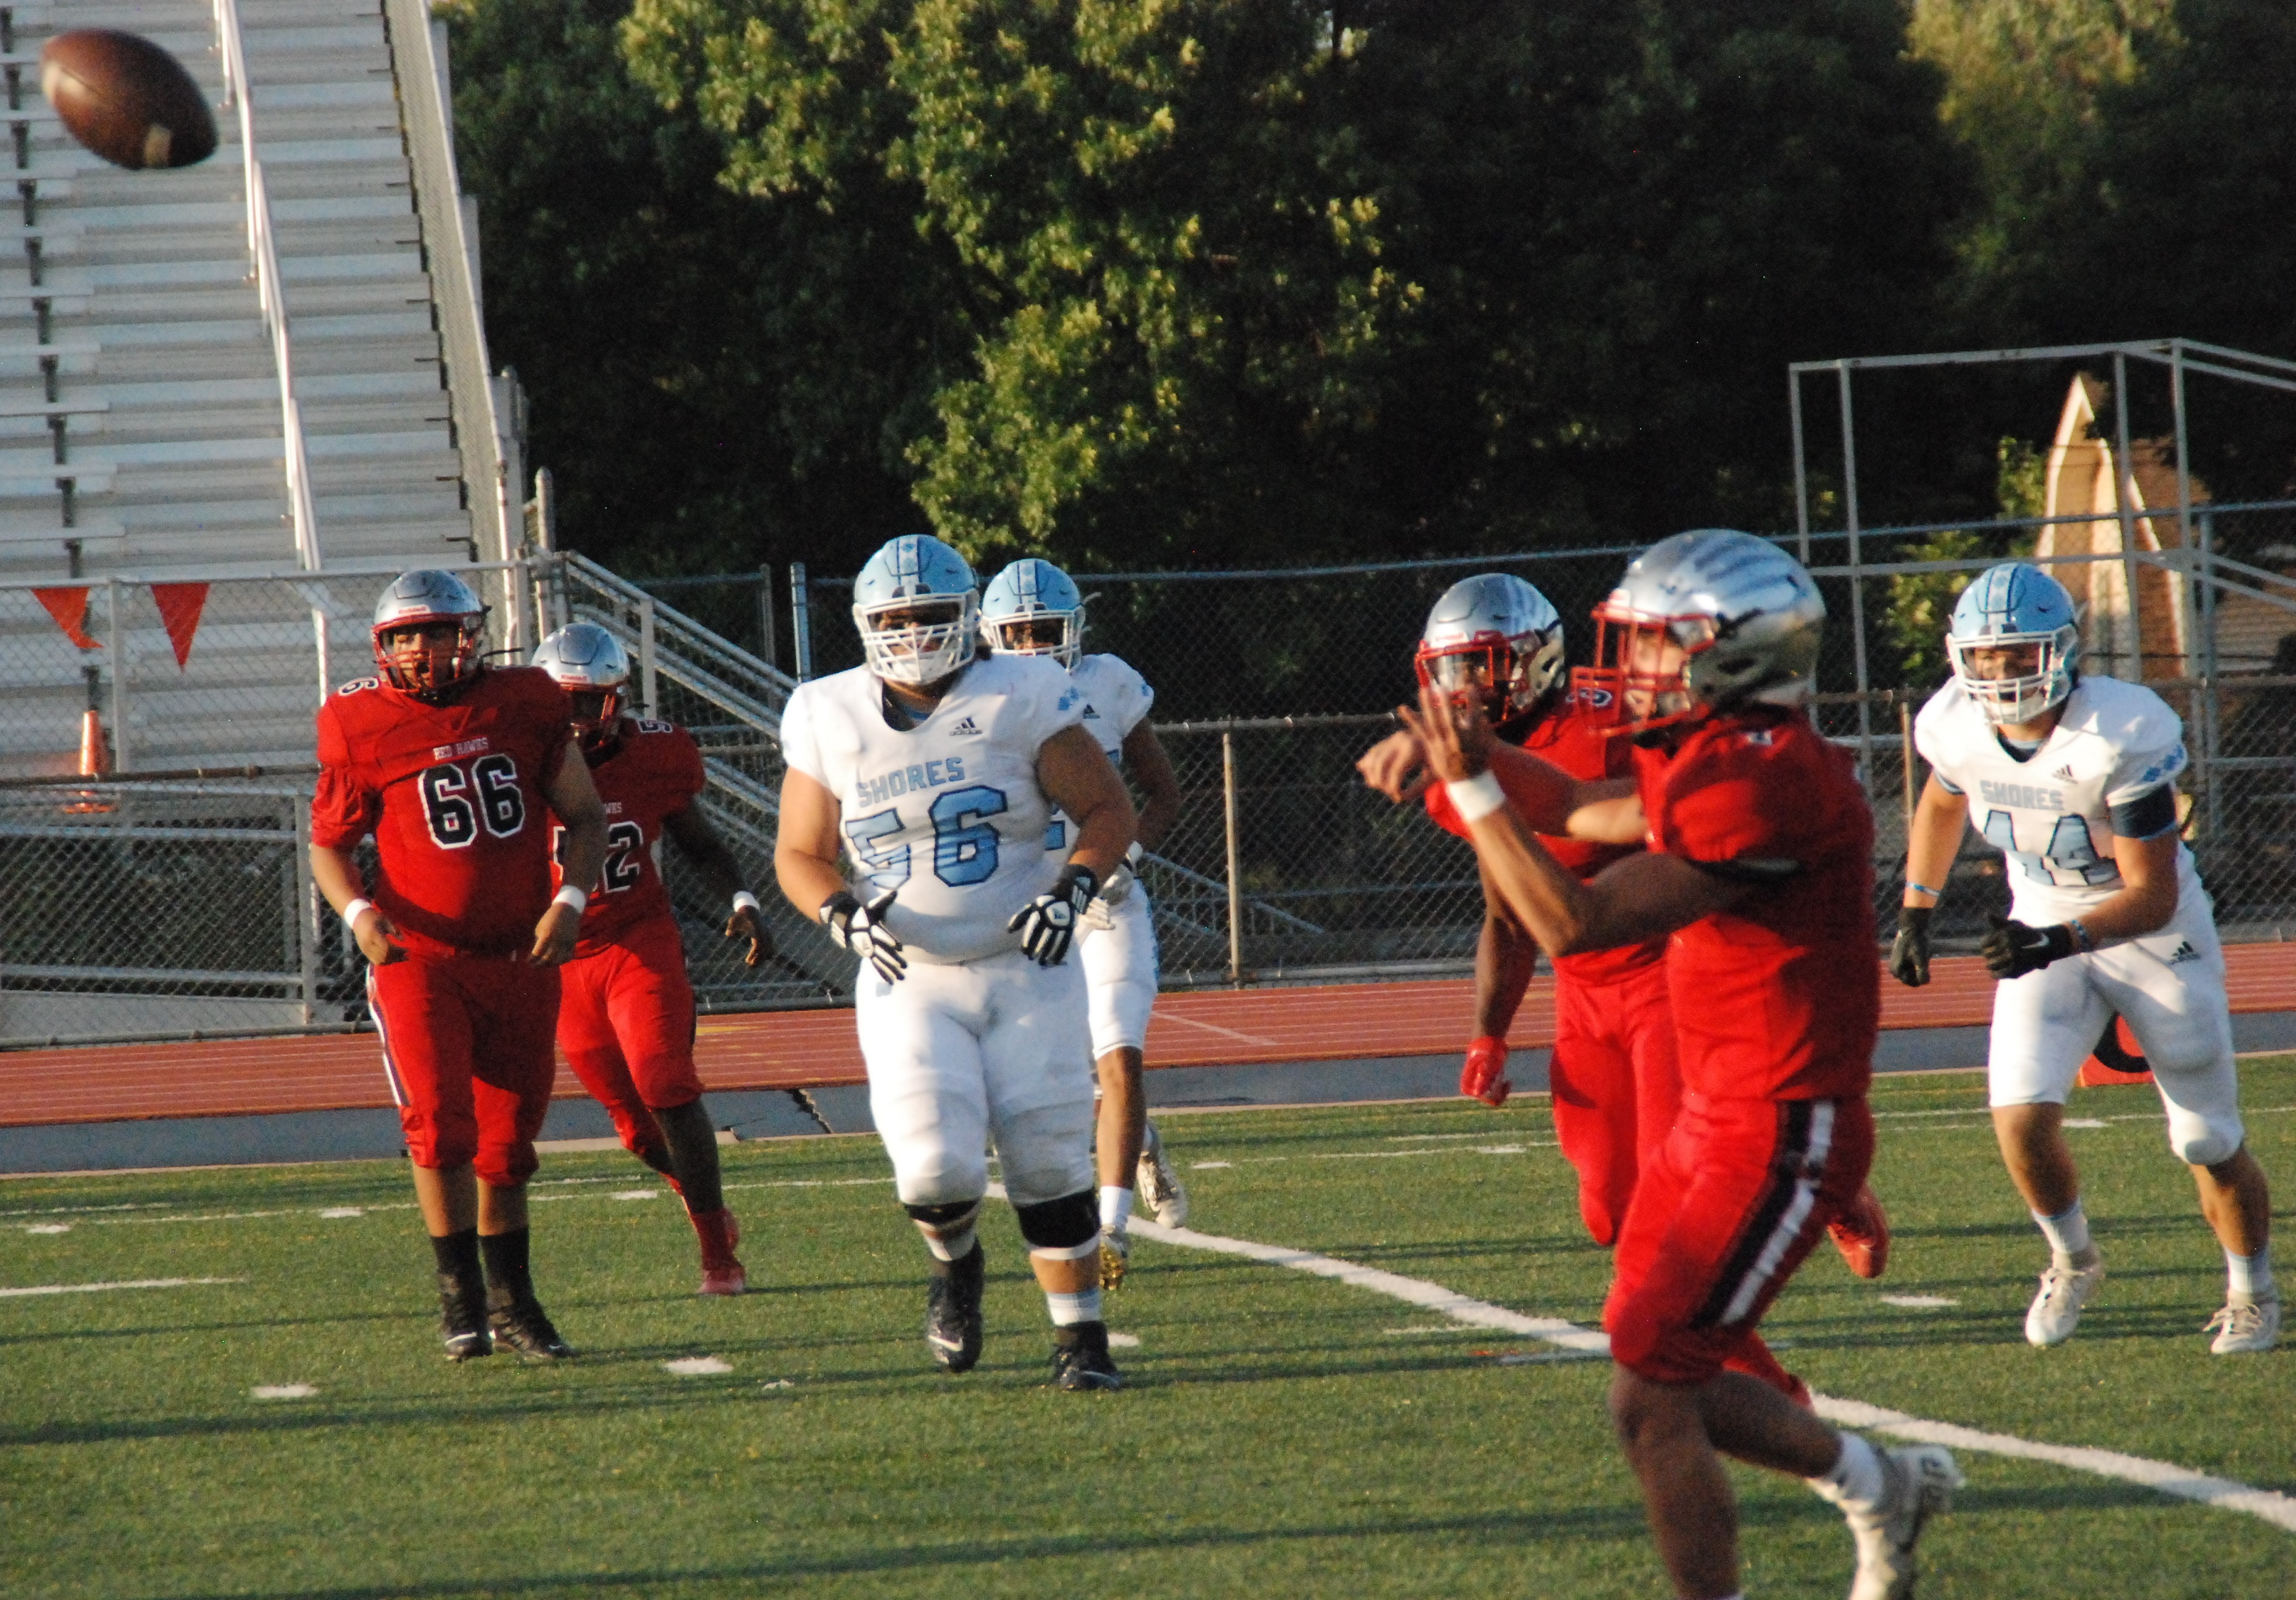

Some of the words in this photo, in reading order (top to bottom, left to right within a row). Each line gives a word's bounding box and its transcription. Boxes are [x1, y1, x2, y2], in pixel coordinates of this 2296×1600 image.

[433, 745, 453, 761] RED
[856, 756, 966, 808] SHORES
[417, 753, 525, 850] 66
[1979, 779, 2065, 811] SHORES
[553, 820, 644, 894] 2
[845, 784, 1009, 890] 56
